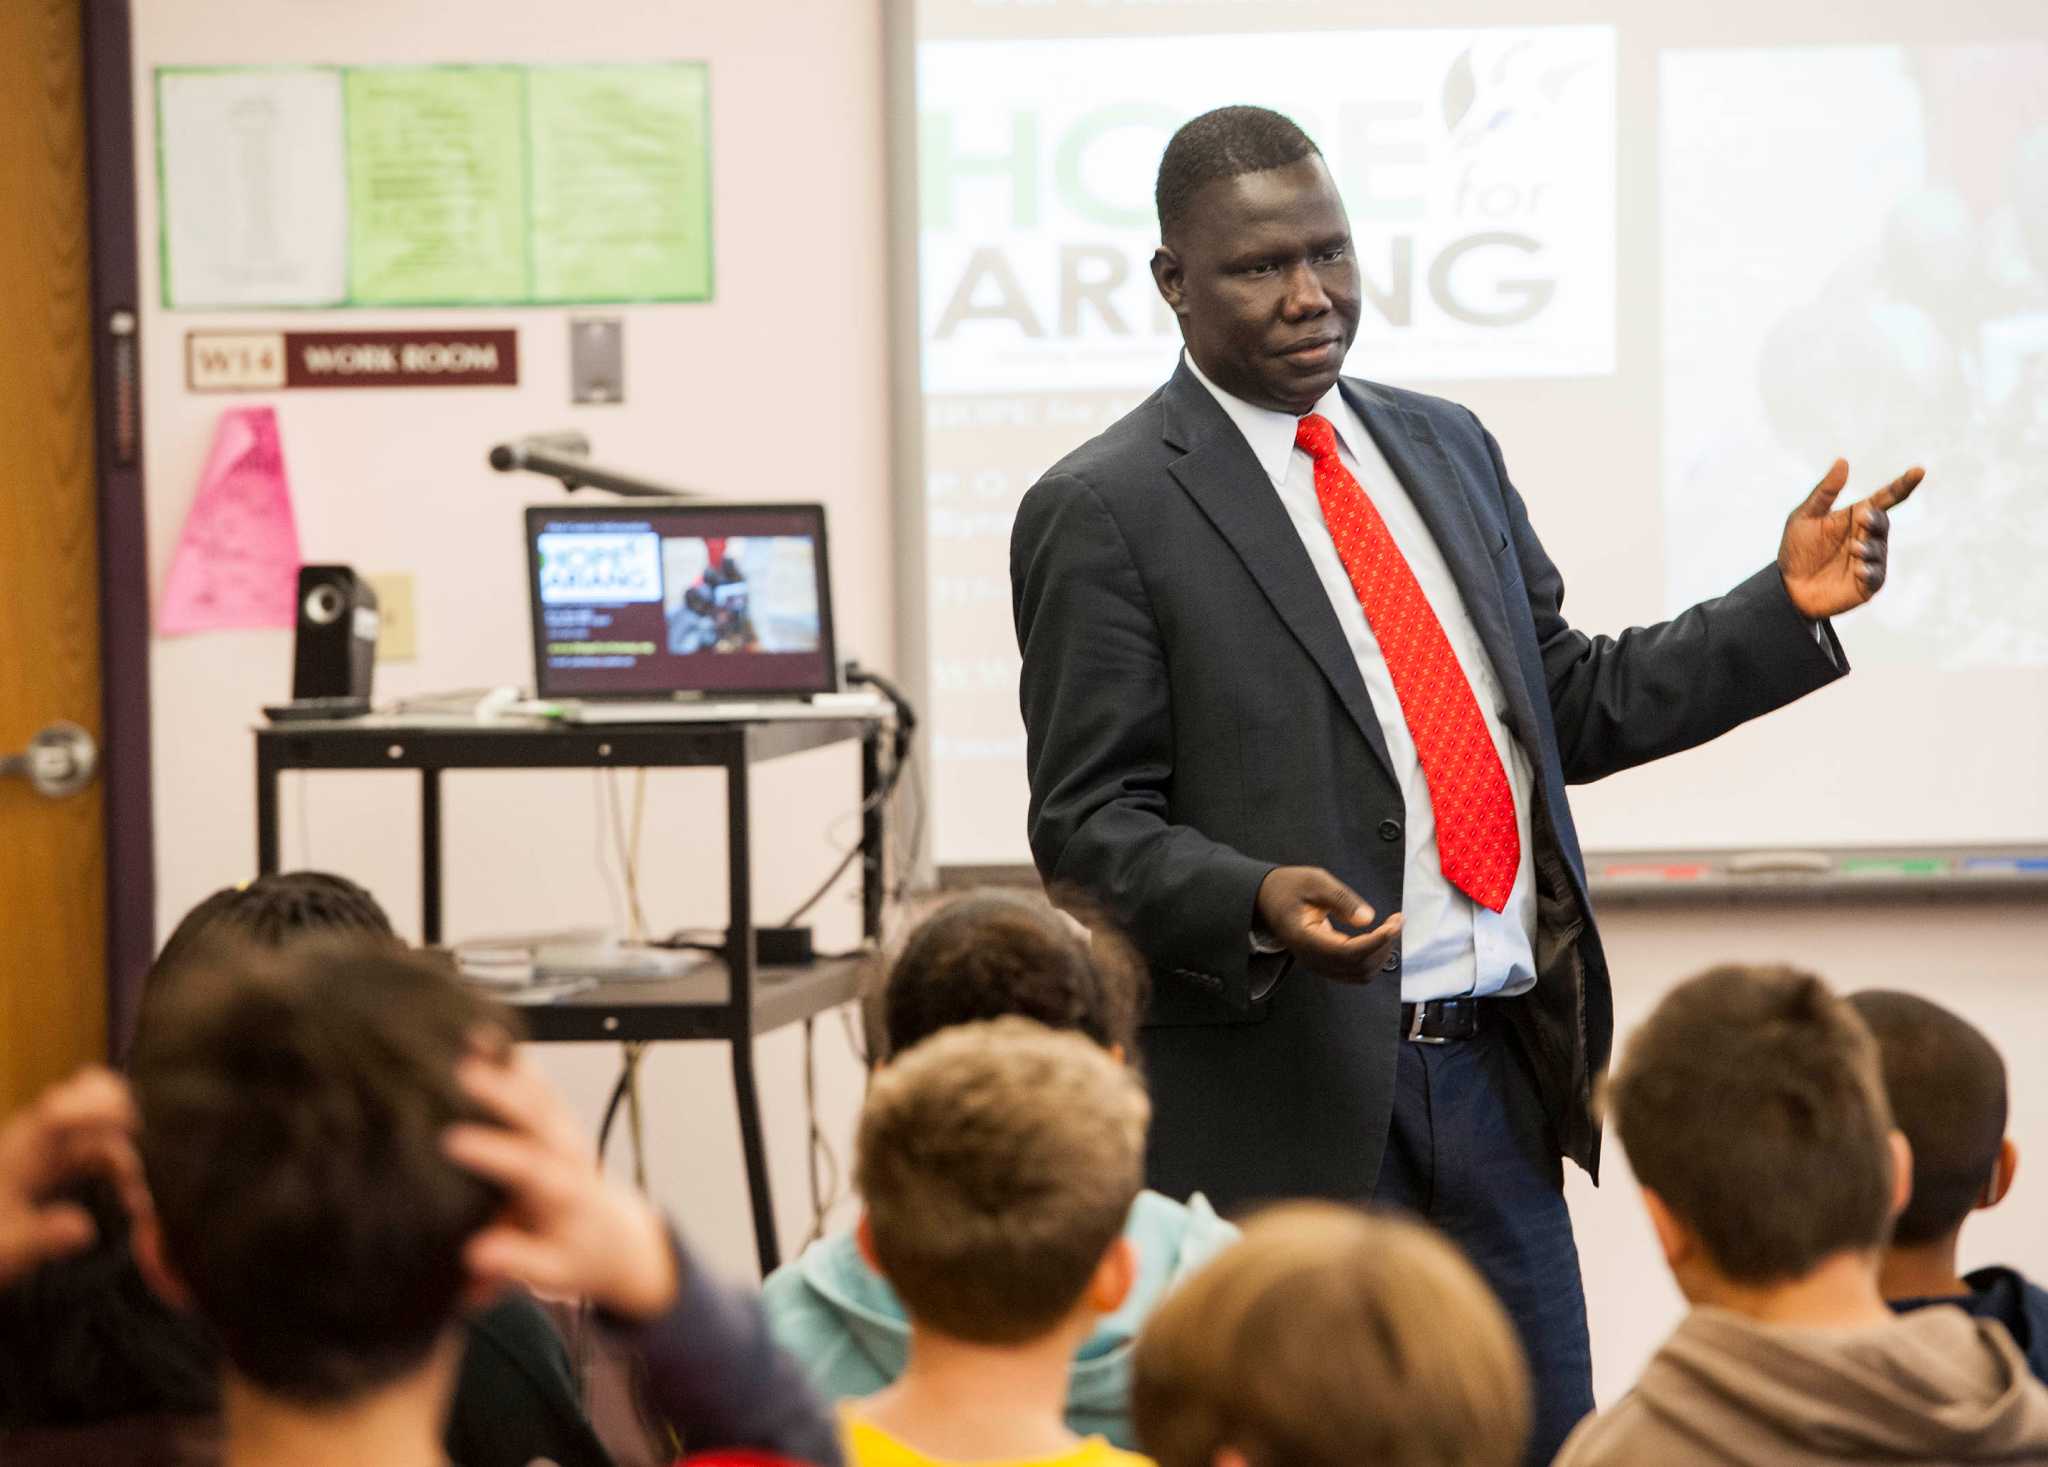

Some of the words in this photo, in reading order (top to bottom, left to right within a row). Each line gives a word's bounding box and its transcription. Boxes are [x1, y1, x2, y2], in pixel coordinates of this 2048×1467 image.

[919, 99, 1428, 231] HOE
[1452, 160, 1551, 220] for
[932, 231, 1558, 340] ARNG
[303, 343, 399, 375] WORK
[400, 342, 499, 374] ROOM
